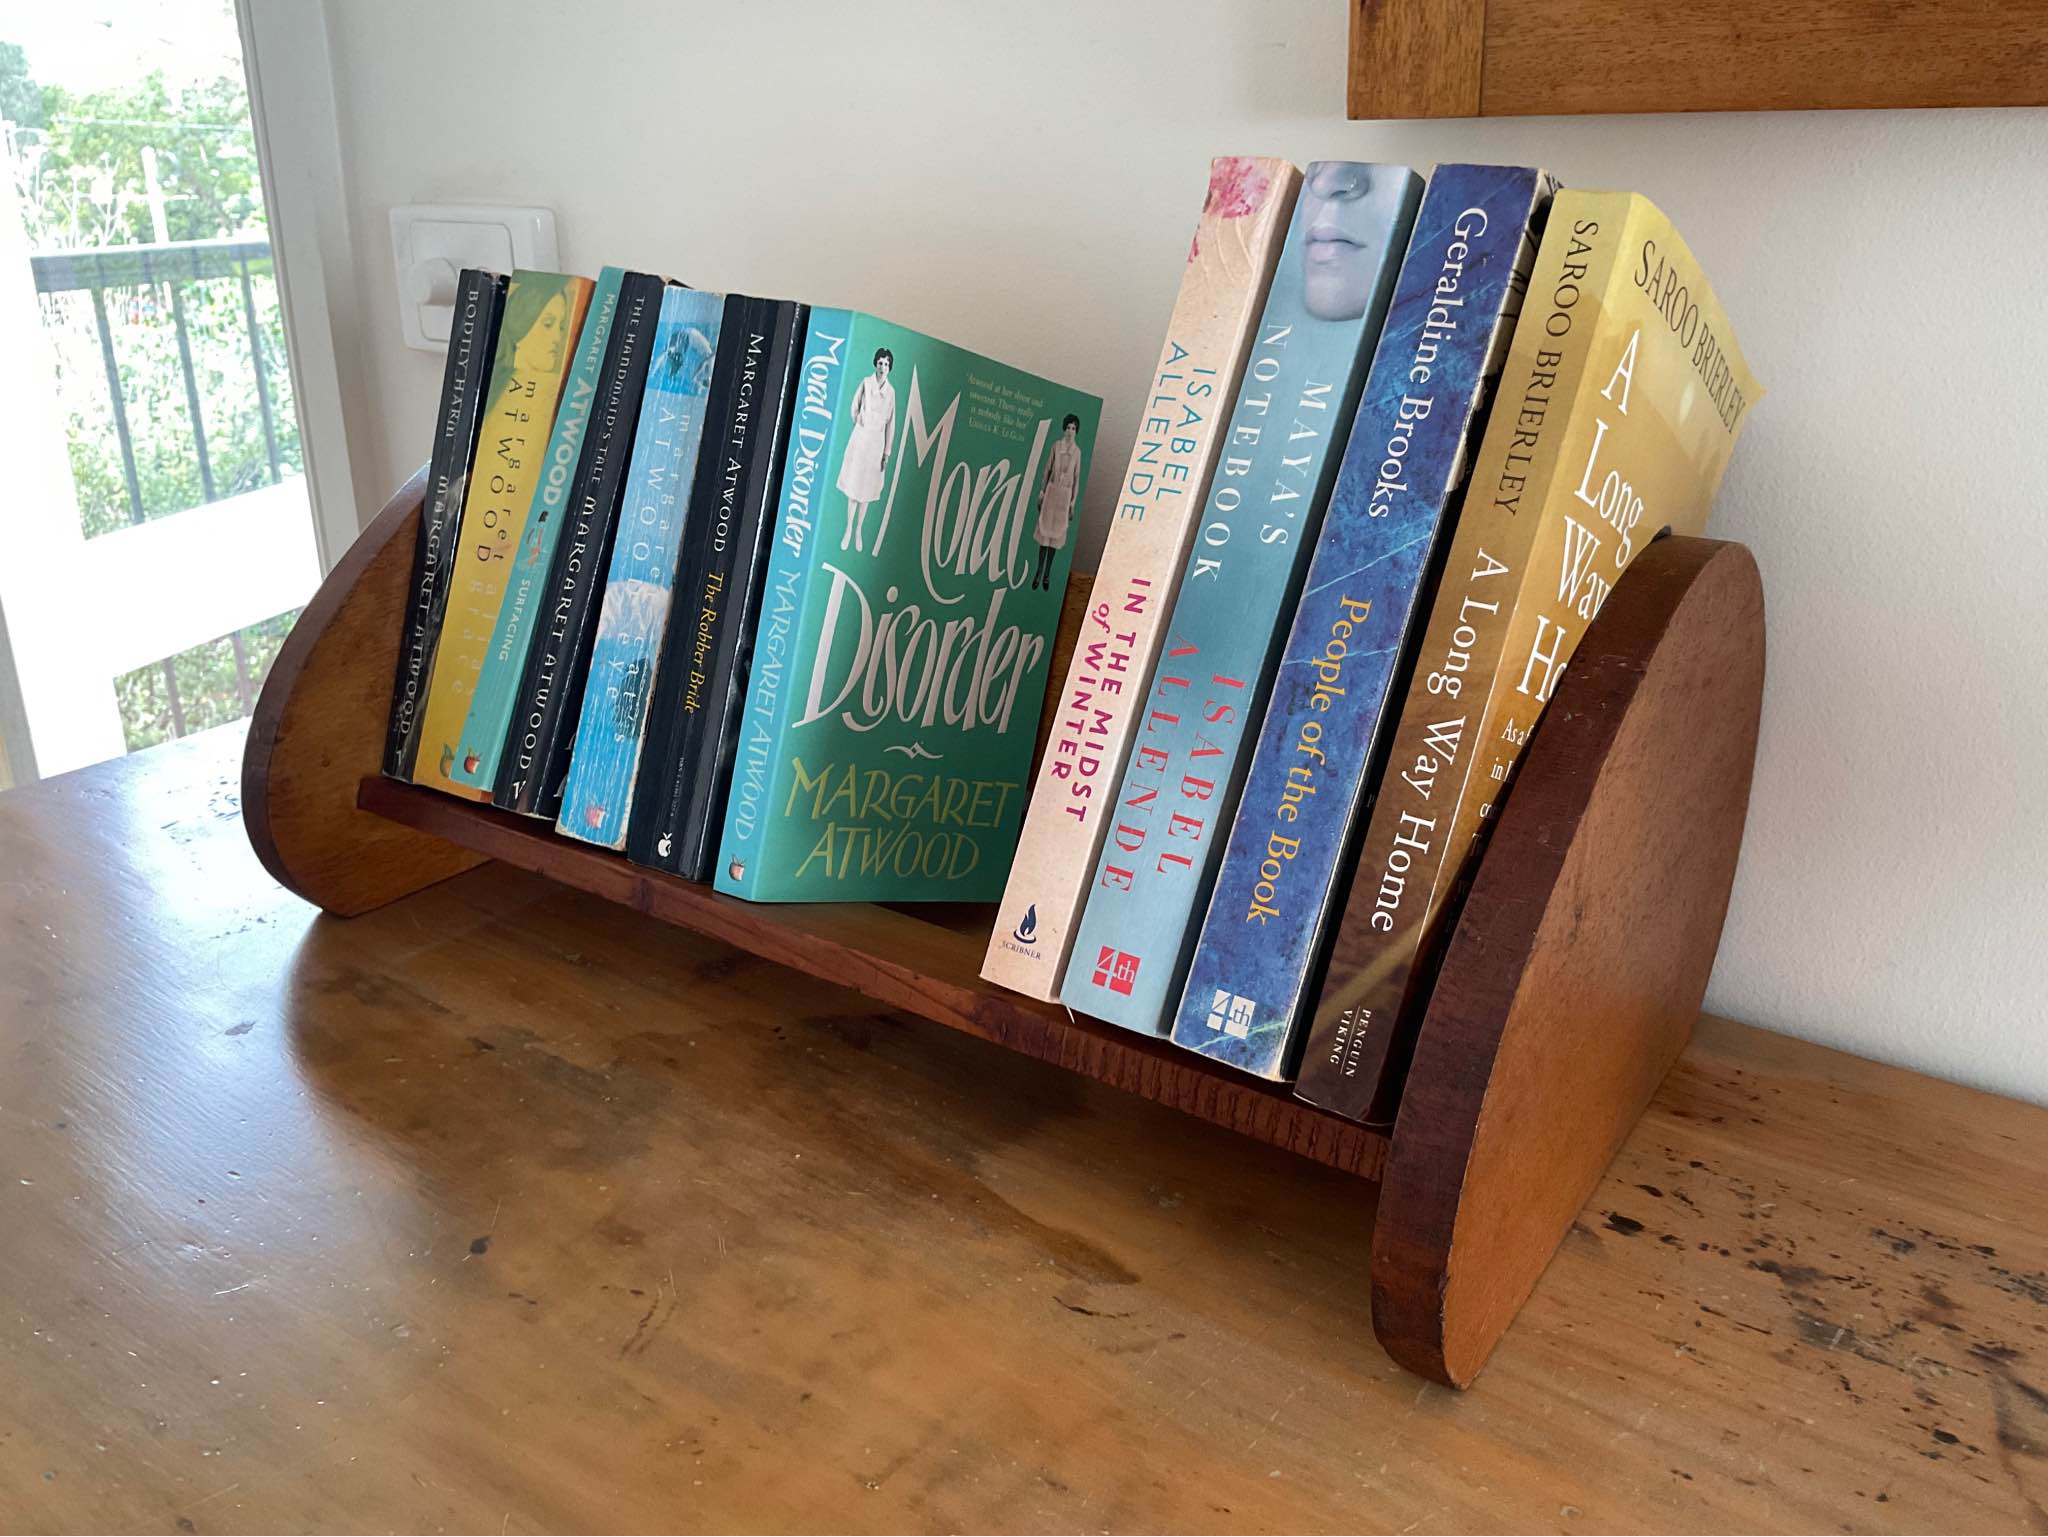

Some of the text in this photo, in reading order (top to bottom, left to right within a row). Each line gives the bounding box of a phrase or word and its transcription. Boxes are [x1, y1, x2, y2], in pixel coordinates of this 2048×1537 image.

[630, 296, 645, 327] THE
[1368, 207, 1489, 519] Geraldine Brooks
[1495, 219, 1599, 516] SAROO BRIERLEY
[1600, 328, 1641, 416] A
[1635, 240, 1747, 434] SAROO BRIERLEY
[401, 290, 480, 734] BODILY HARM MARGARET ATWOOD
[477, 378, 522, 562] ATWOOD
[494, 380, 537, 561] margaret
[499, 293, 616, 662] MARGARET ATWOOD SURFACING
[591, 446, 609, 485] TALE
[628, 406, 675, 595] ATWOOD
[872, 363, 1053, 605] Moral
[1120, 341, 1189, 522] ALLENDE
[1156, 367, 1216, 501] ISABEL
[1191, 324, 1293, 582] NOTEBOOK
[1260, 378, 1333, 545] MAYA'S
[1574, 418, 1644, 569] Long
[552, 495, 597, 643] MARGARET
[684, 332, 765, 714] MARGARET ATWOOD The Robber Bride
[735, 331, 845, 840] Moral Disorder MARGARET ATWOOD
[519, 653, 557, 770] ATWOOD
[606, 631, 629, 698] eye
[792, 561, 1044, 734] Disorder
[1051, 603, 1110, 780] of WINTER
[1065, 577, 1151, 822] IN THE MIDST
[784, 756, 1019, 829] MARGARET
[1102, 633, 1200, 892] ALLENDE
[1157, 672, 1246, 874] ISABEL
[1246, 593, 1372, 926] People of the Book
[1371, 547, 1509, 932] A Long Way Home
[795, 821, 979, 880] ATWOOD
[1001, 939, 1042, 961] SCRIBNER
[1329, 1009, 1353, 1065] VIKING
[1343, 1007, 1371, 1078] PENGUIN
